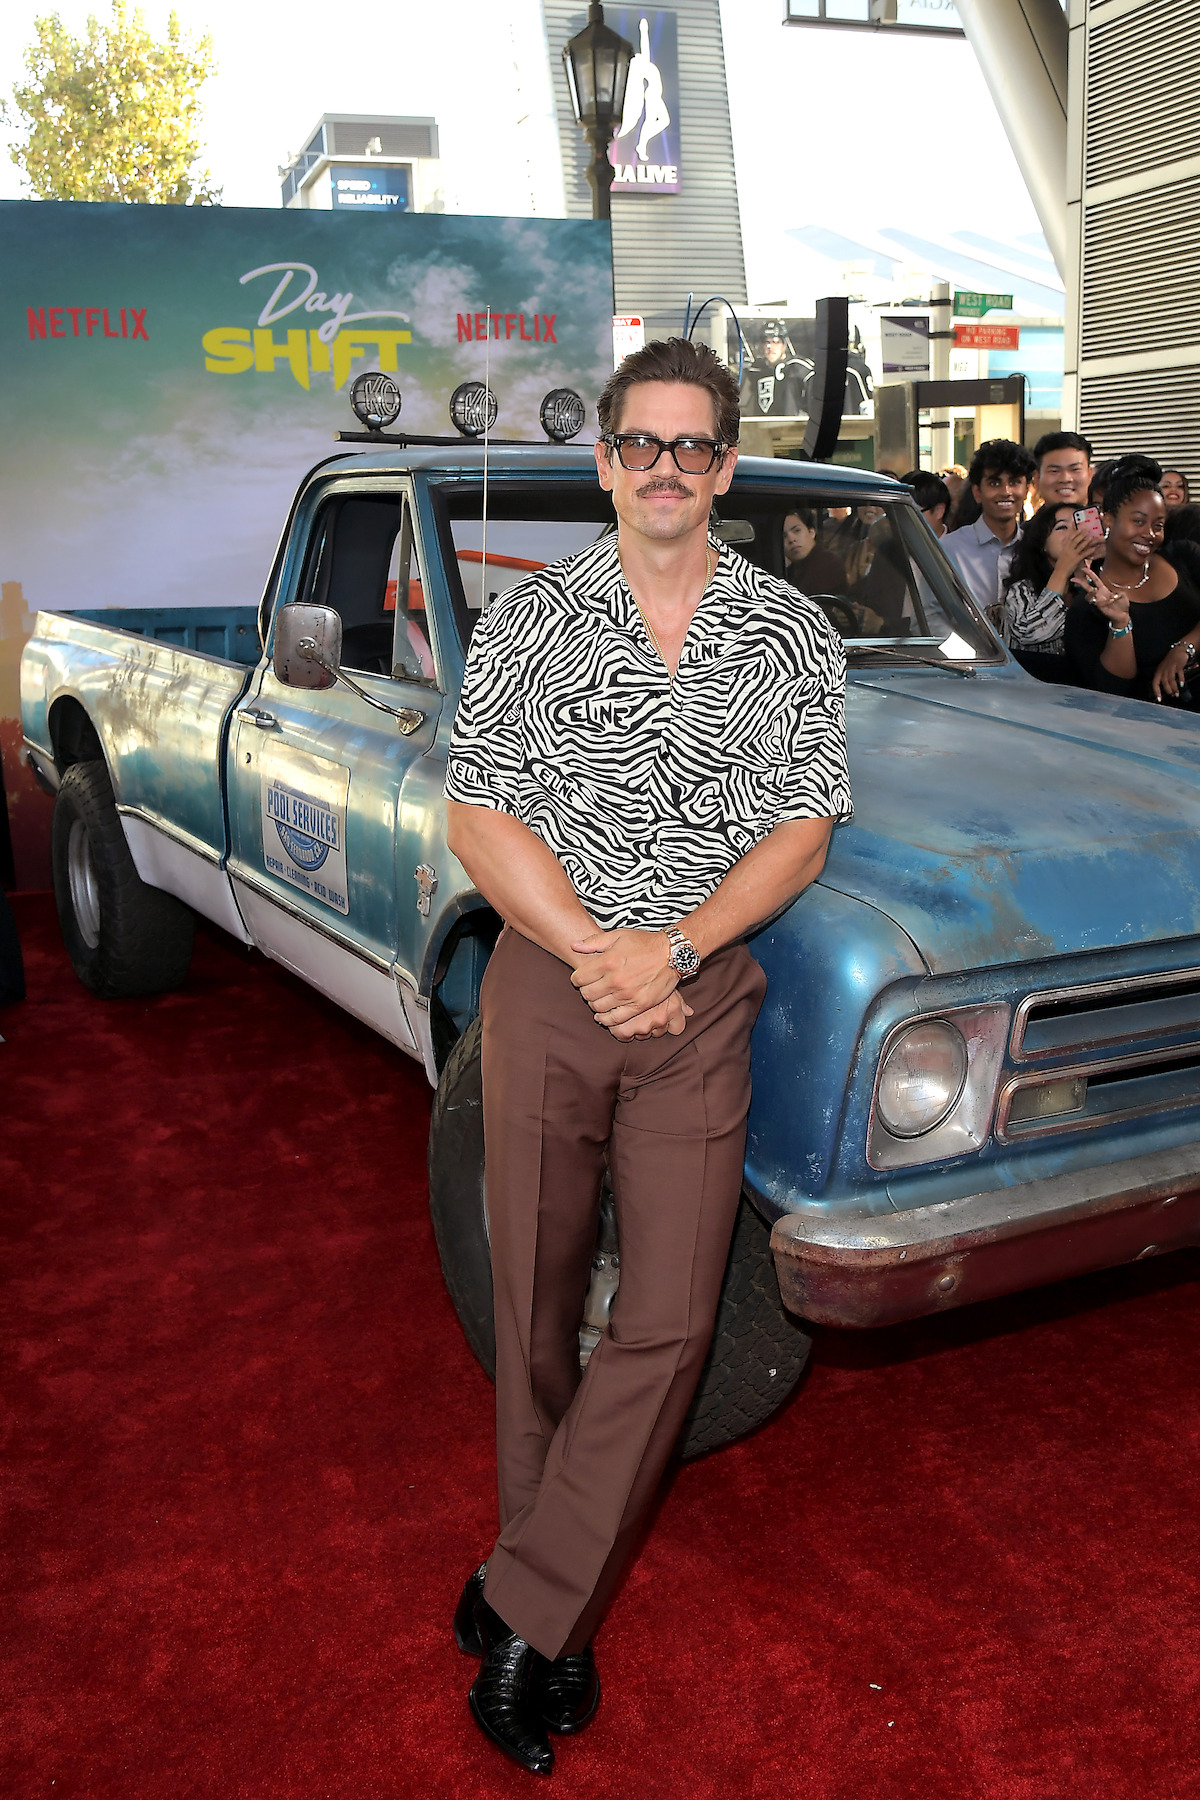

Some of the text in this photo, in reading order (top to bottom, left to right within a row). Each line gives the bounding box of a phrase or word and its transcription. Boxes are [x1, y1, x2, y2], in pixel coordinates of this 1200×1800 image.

[637, 164, 678, 184] LIVE
[239, 262, 410, 344] Day
[958, 293, 1010, 308] WEST ROAD
[26, 306, 150, 341] NETFLIX
[456, 313, 558, 344] NETFLIX
[960, 335, 1011, 344] ON WEST ROAD
[978, 327, 1007, 336] PARKING
[202, 327, 412, 391] SHIFT
[364, 375, 399, 418] KC
[463, 387, 497, 429] KC
[554, 394, 585, 436] KC
[267, 787, 337, 845] POOL SERVICES
